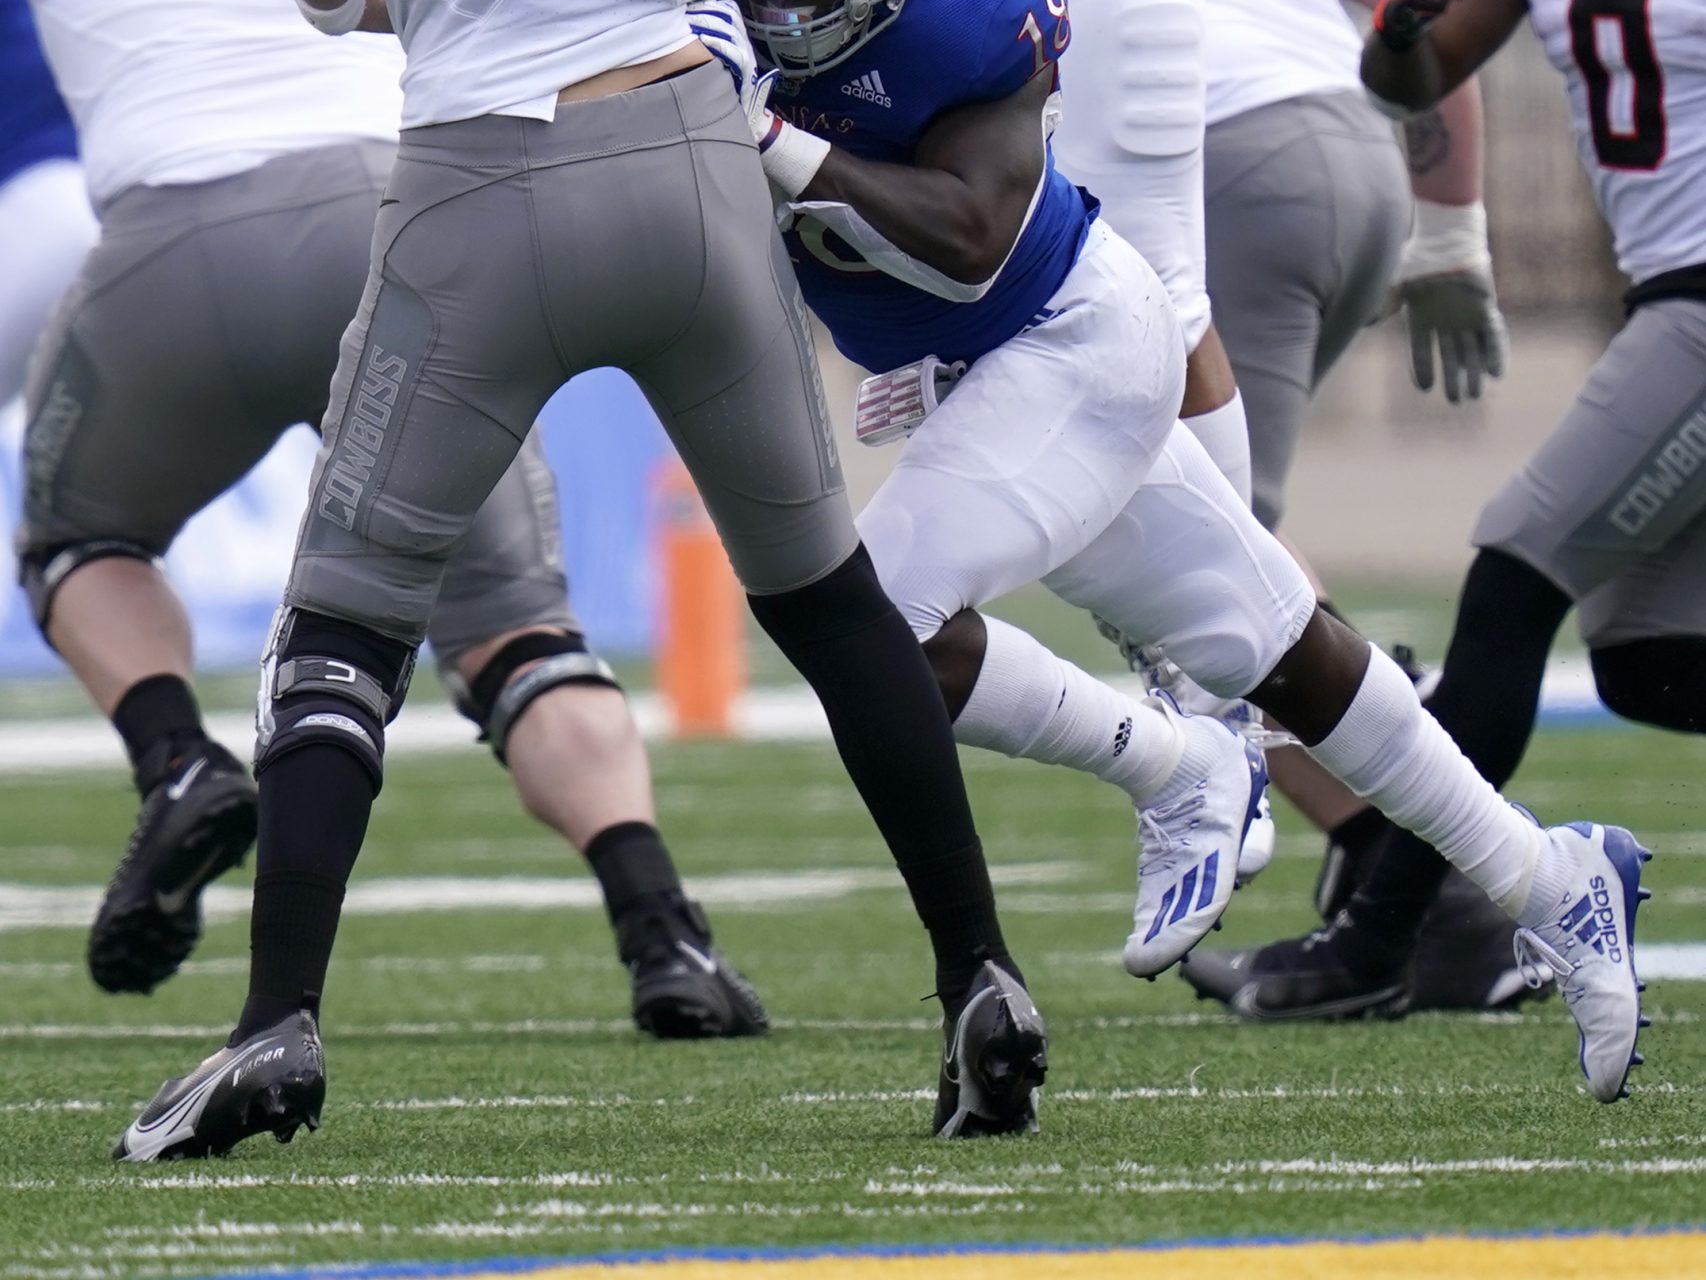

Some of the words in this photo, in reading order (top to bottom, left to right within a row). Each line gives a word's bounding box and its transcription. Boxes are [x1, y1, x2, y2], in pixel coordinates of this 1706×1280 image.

[841, 83, 892, 108] adidas
[318, 343, 408, 532] COWBOYS
[1608, 402, 1706, 537] COWBO
[1589, 875, 1622, 963] adidas
[239, 1046, 285, 1081] VAPOR
